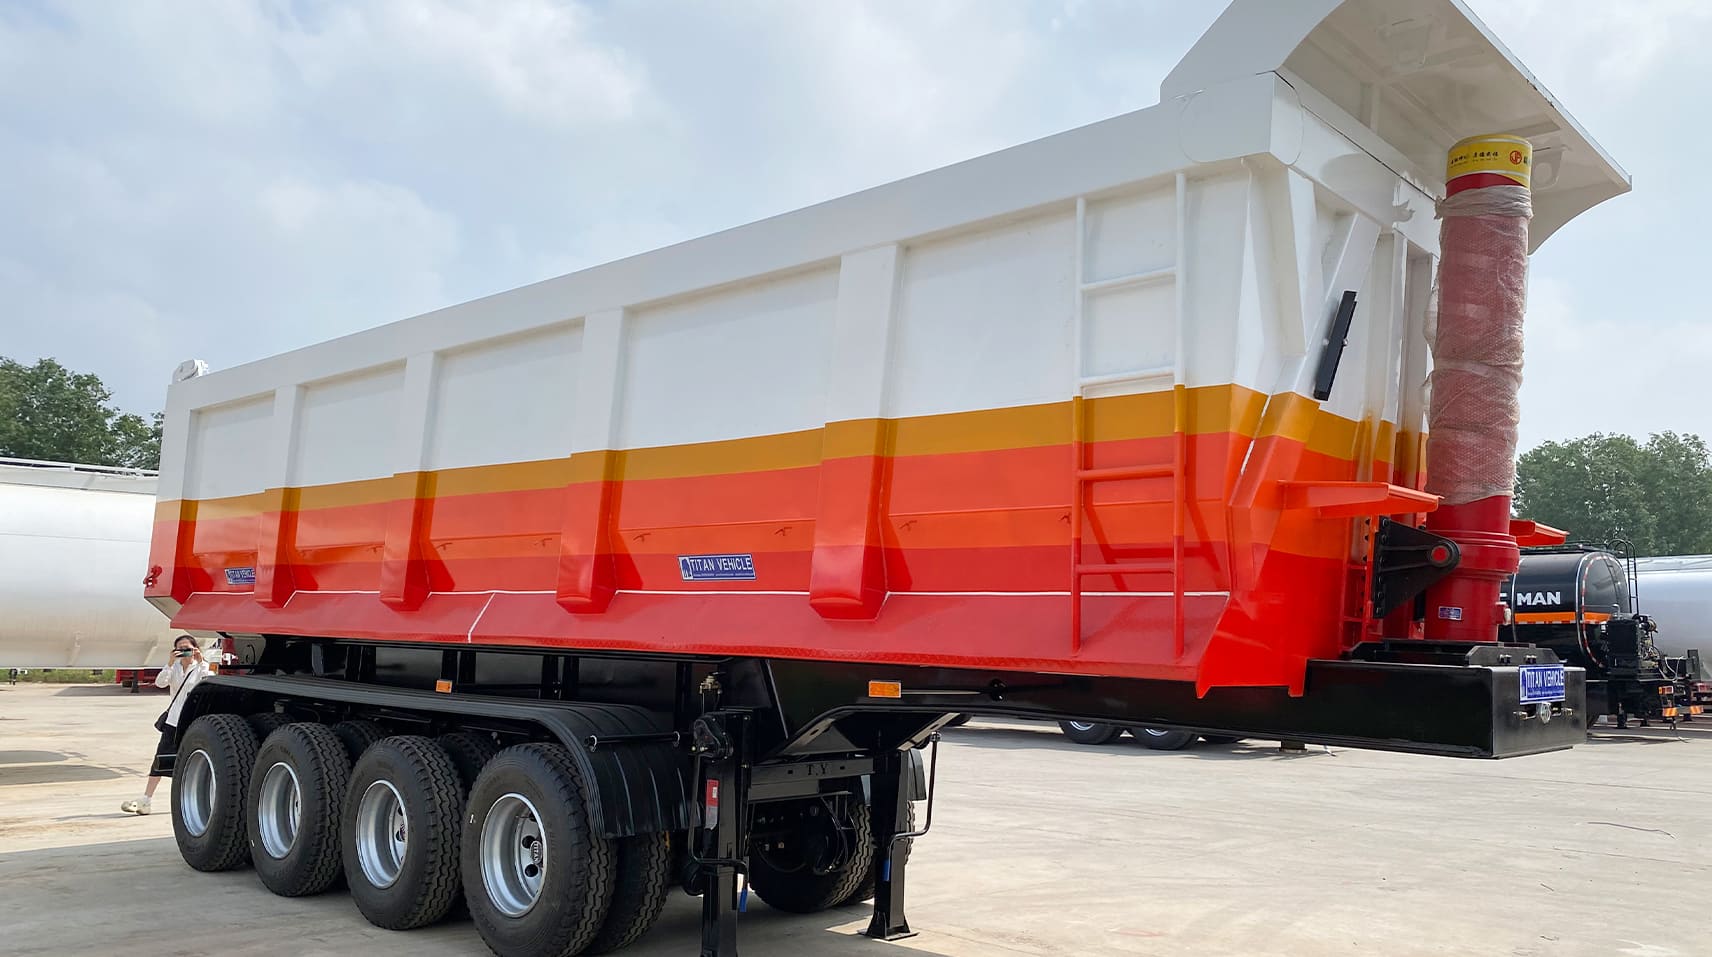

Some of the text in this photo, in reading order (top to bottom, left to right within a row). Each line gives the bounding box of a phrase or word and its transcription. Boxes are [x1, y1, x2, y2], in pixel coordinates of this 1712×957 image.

[690, 557, 753, 571] TITAN VEHICLE
[1516, 591, 1561, 606] MAN
[1527, 670, 1565, 689] TITAN VEHICLE
